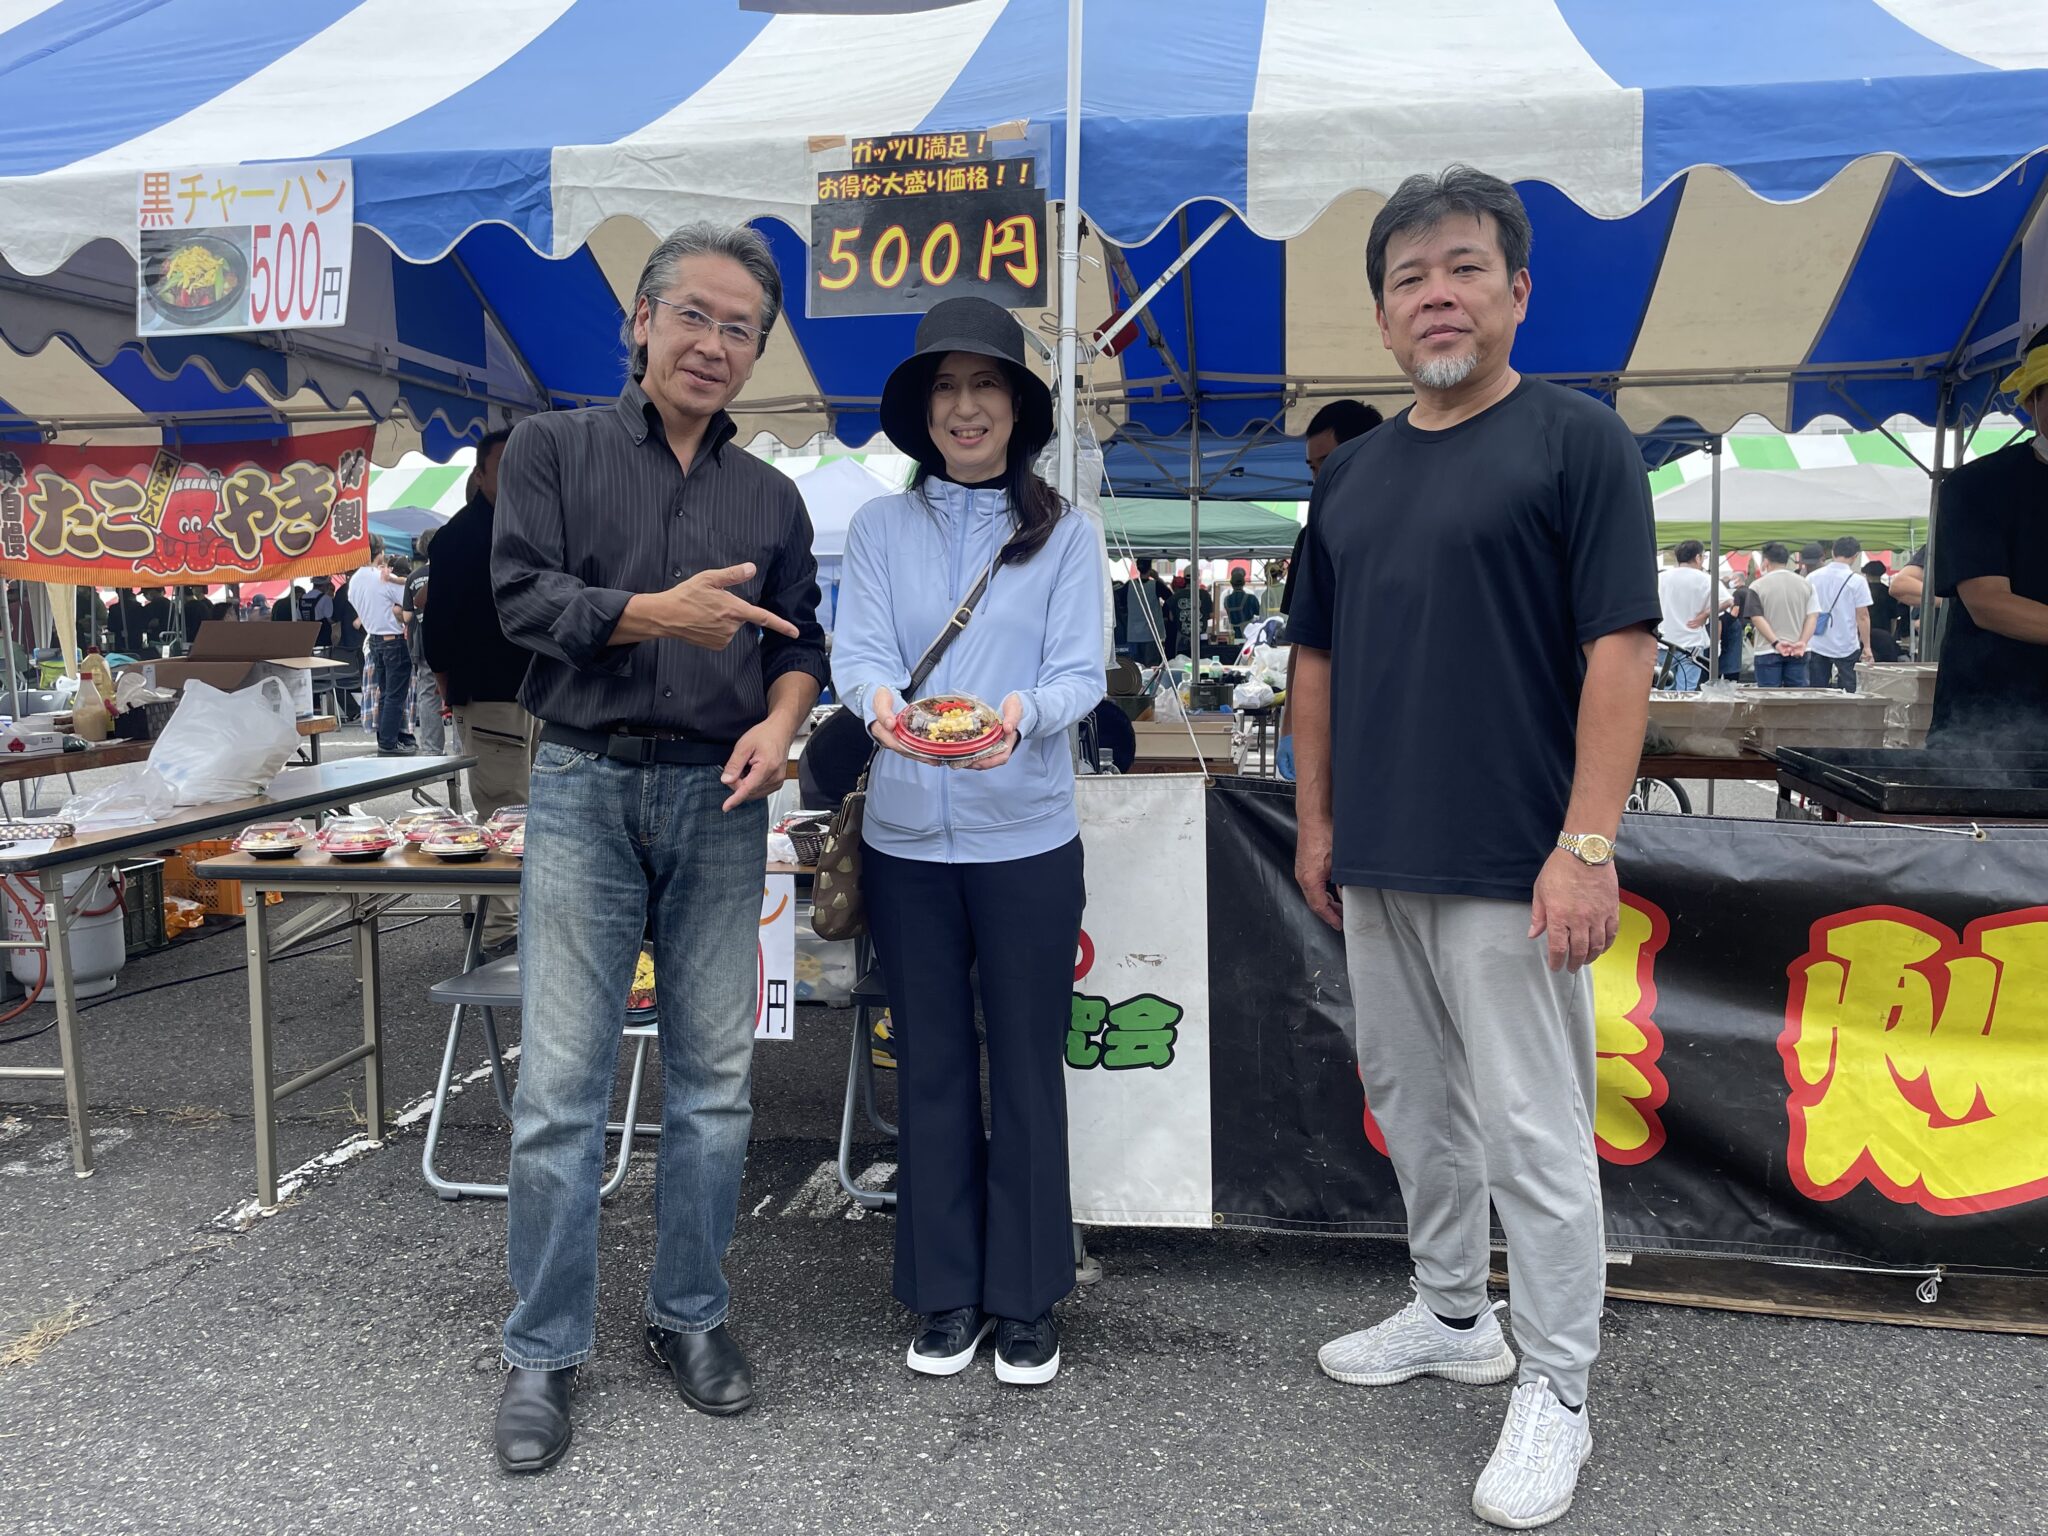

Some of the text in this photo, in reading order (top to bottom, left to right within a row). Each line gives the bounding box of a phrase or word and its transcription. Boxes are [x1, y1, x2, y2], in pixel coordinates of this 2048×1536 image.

[852, 134, 987, 164] ガッツリ満足！
[139, 168, 347, 229] 黒チャーハン
[818, 163, 1030, 199] お得な大盛り価格！！
[250, 220, 344, 325] 500円
[818, 214, 1040, 290] 500円
